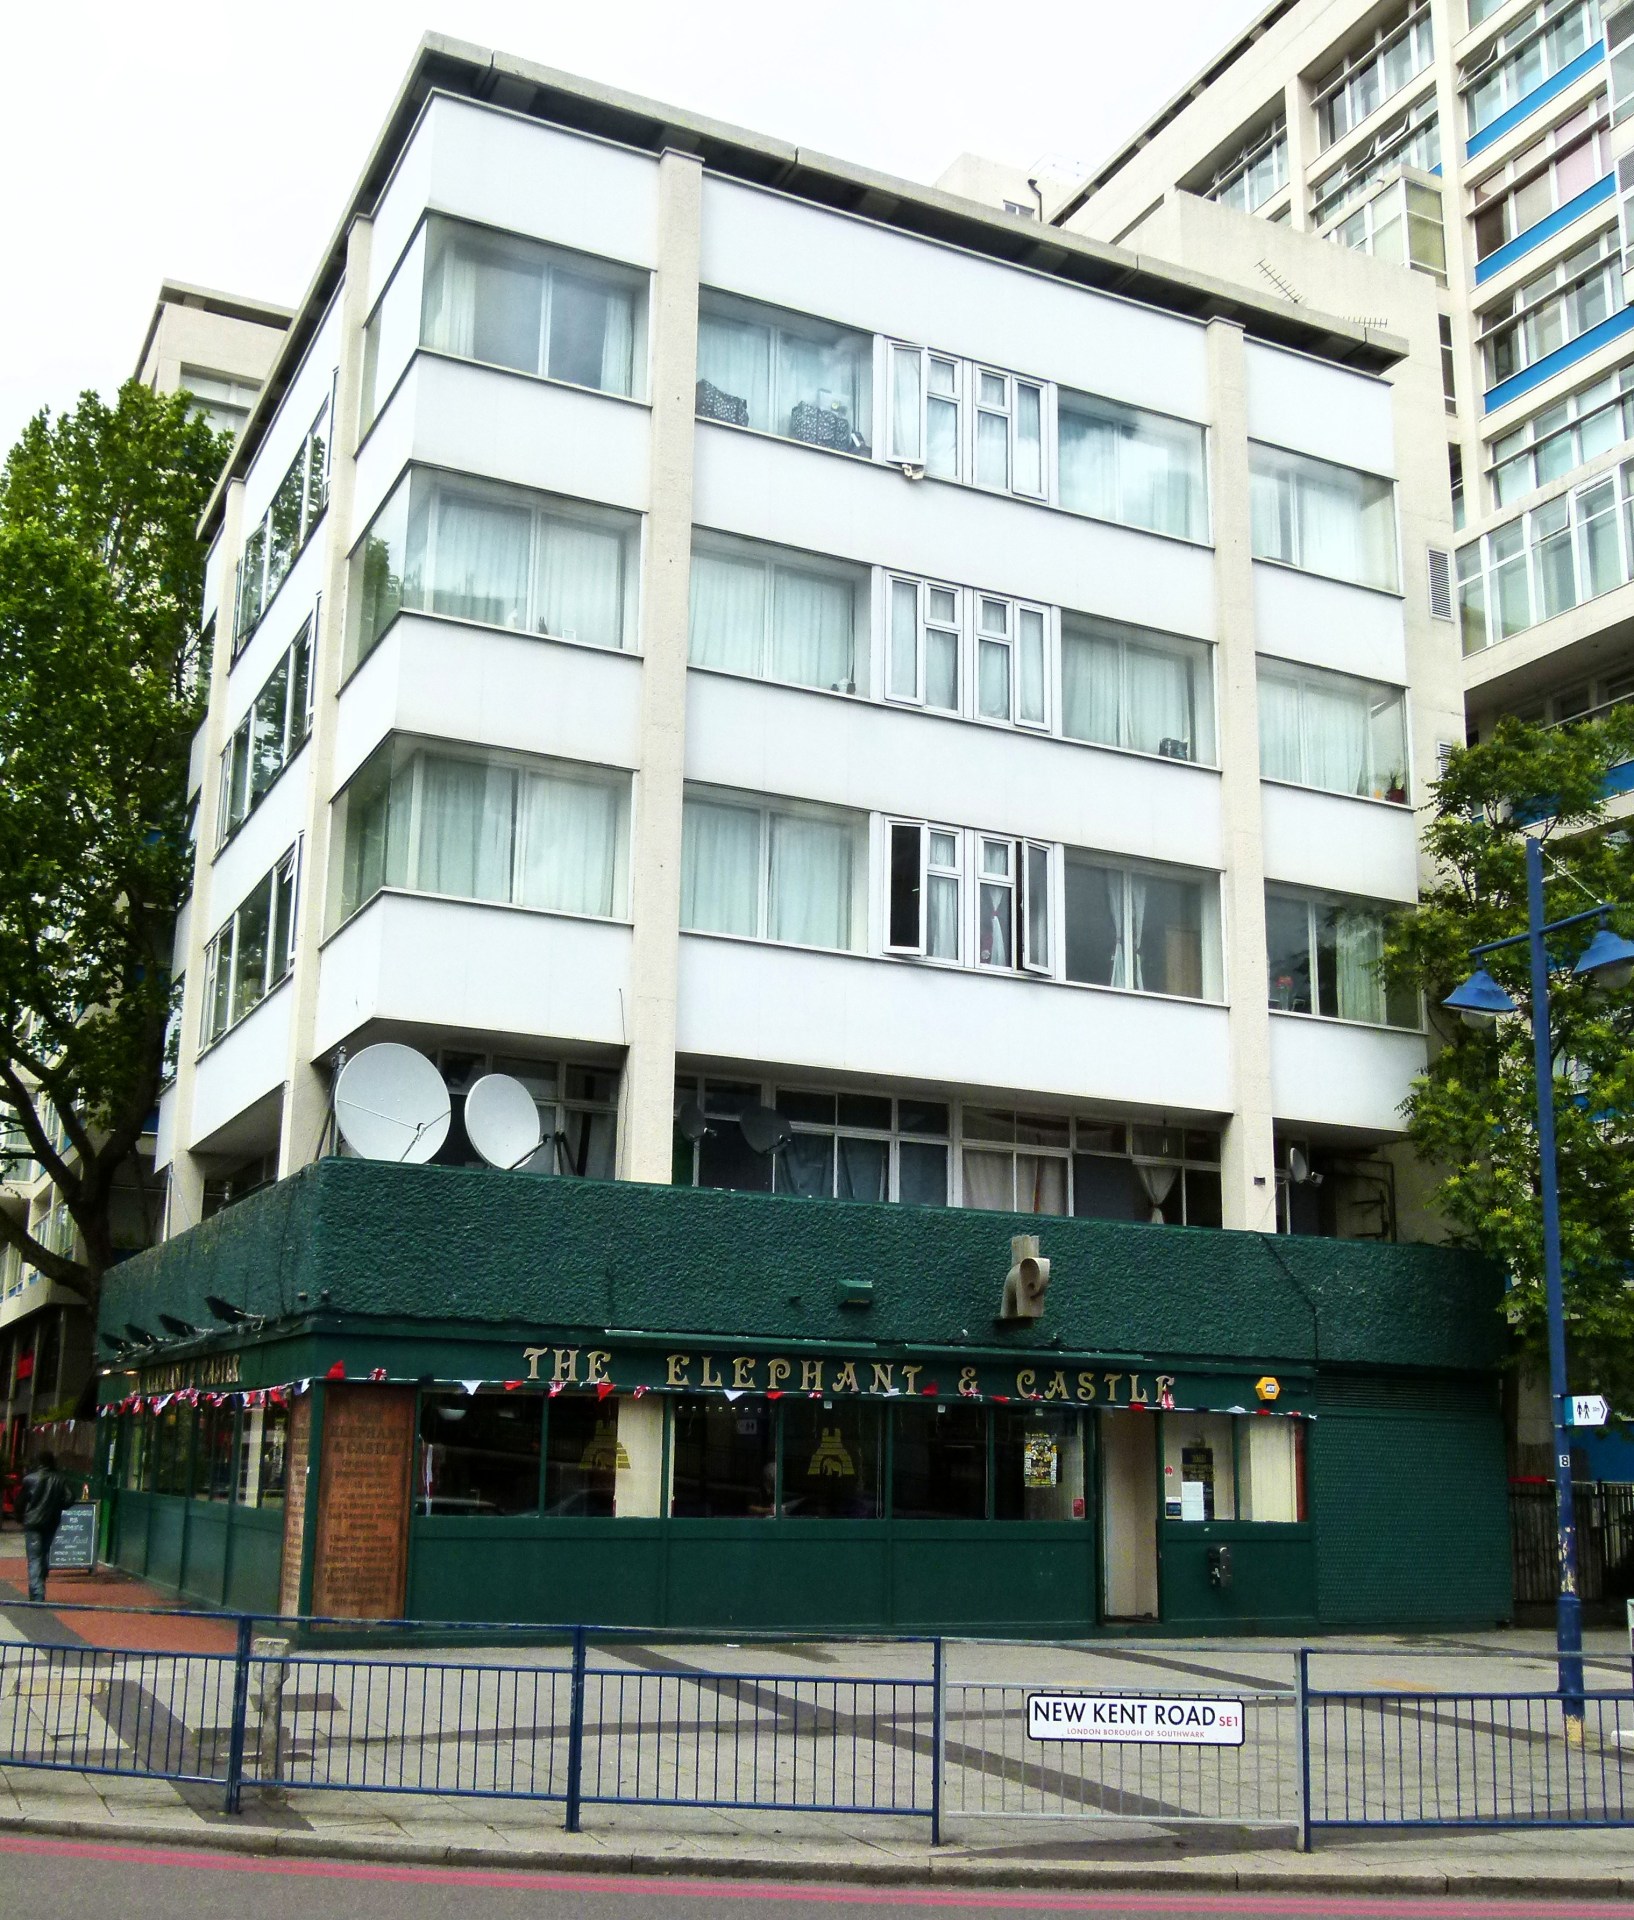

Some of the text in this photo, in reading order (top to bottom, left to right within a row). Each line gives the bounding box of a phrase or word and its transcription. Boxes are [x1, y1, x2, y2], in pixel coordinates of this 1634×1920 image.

[523, 1347, 612, 1383] THE
[666, 1354, 923, 1395] ELEPHANT
[958, 1366, 978, 1395] &
[1561, 1455, 1569, 1466] 8
[1035, 1701, 1238, 1727] NEW KENT ROAD SE1
[1103, 1729, 1142, 1737] BOROUGH
